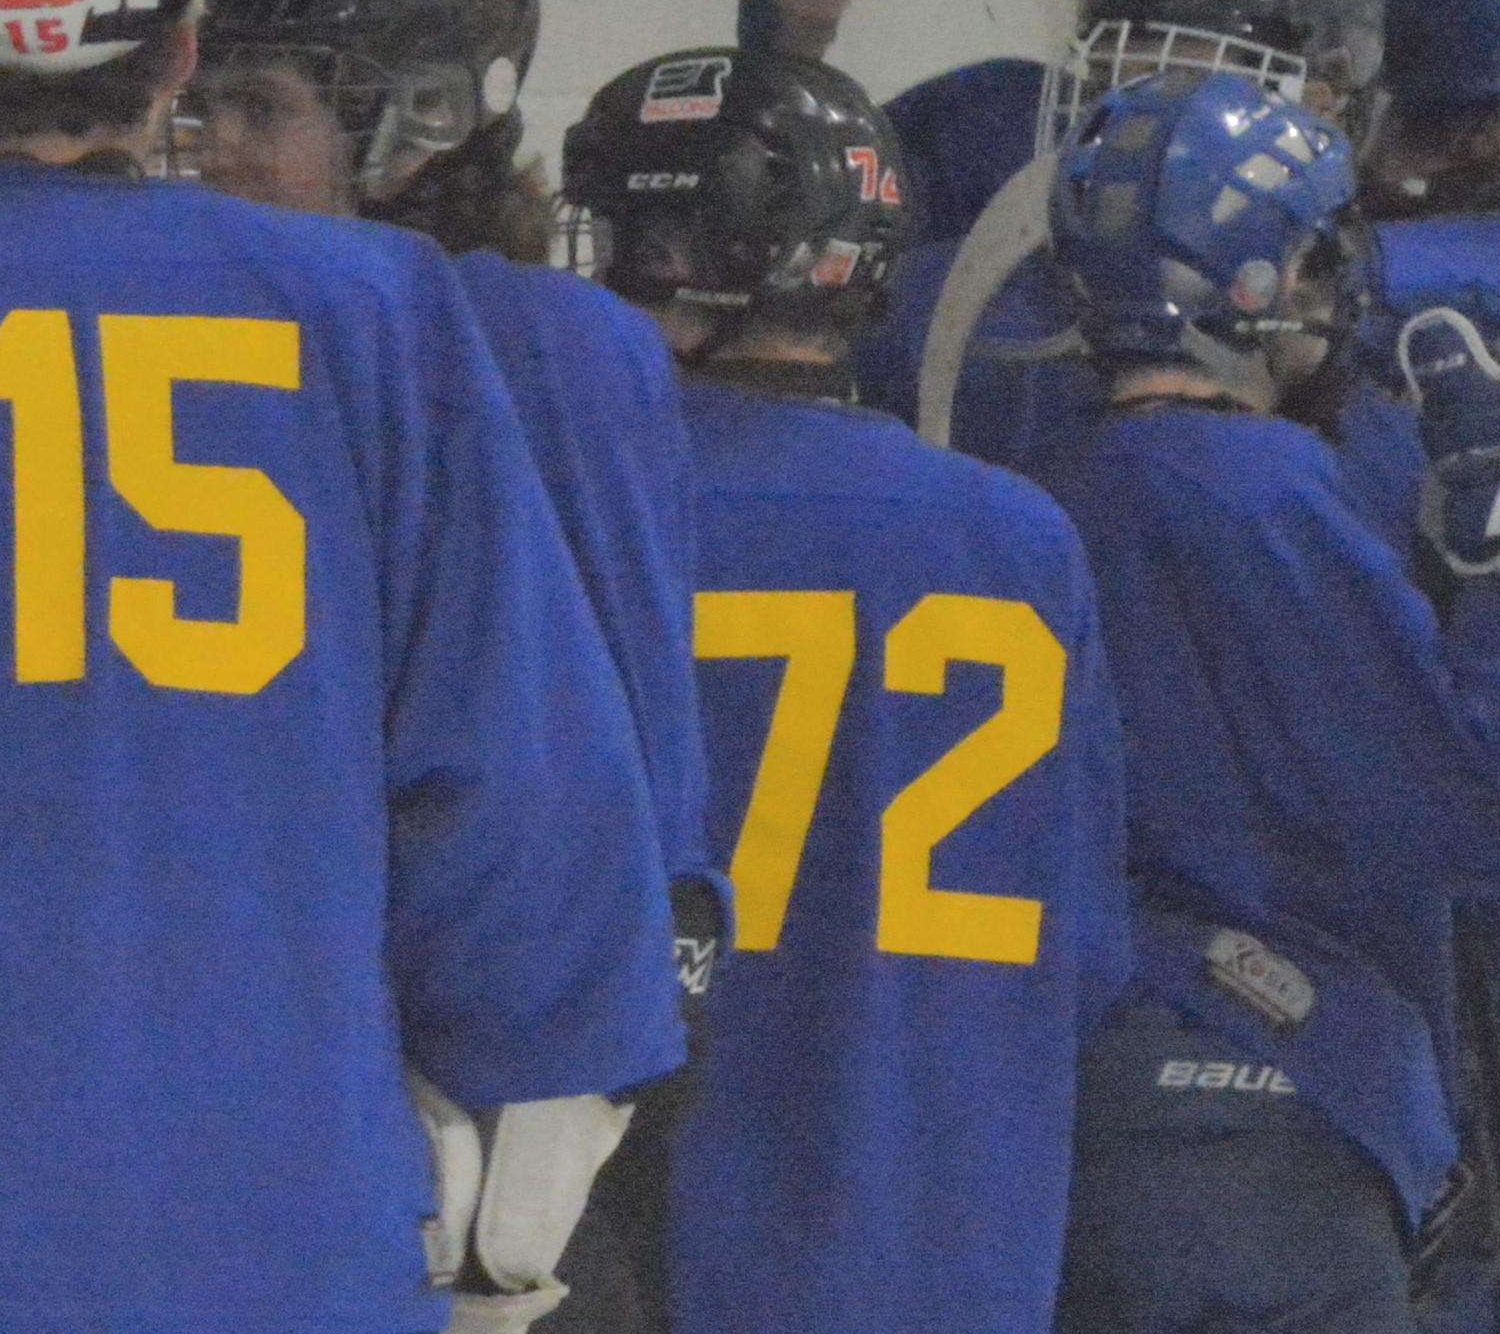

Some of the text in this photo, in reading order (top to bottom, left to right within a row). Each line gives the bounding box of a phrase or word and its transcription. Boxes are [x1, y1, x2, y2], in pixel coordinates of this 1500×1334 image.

[5, 19, 70, 55] 15
[627, 172, 700, 190] CCM
[692, 590, 1067, 964] 72
[1157, 1060, 1298, 1093] BAUE
